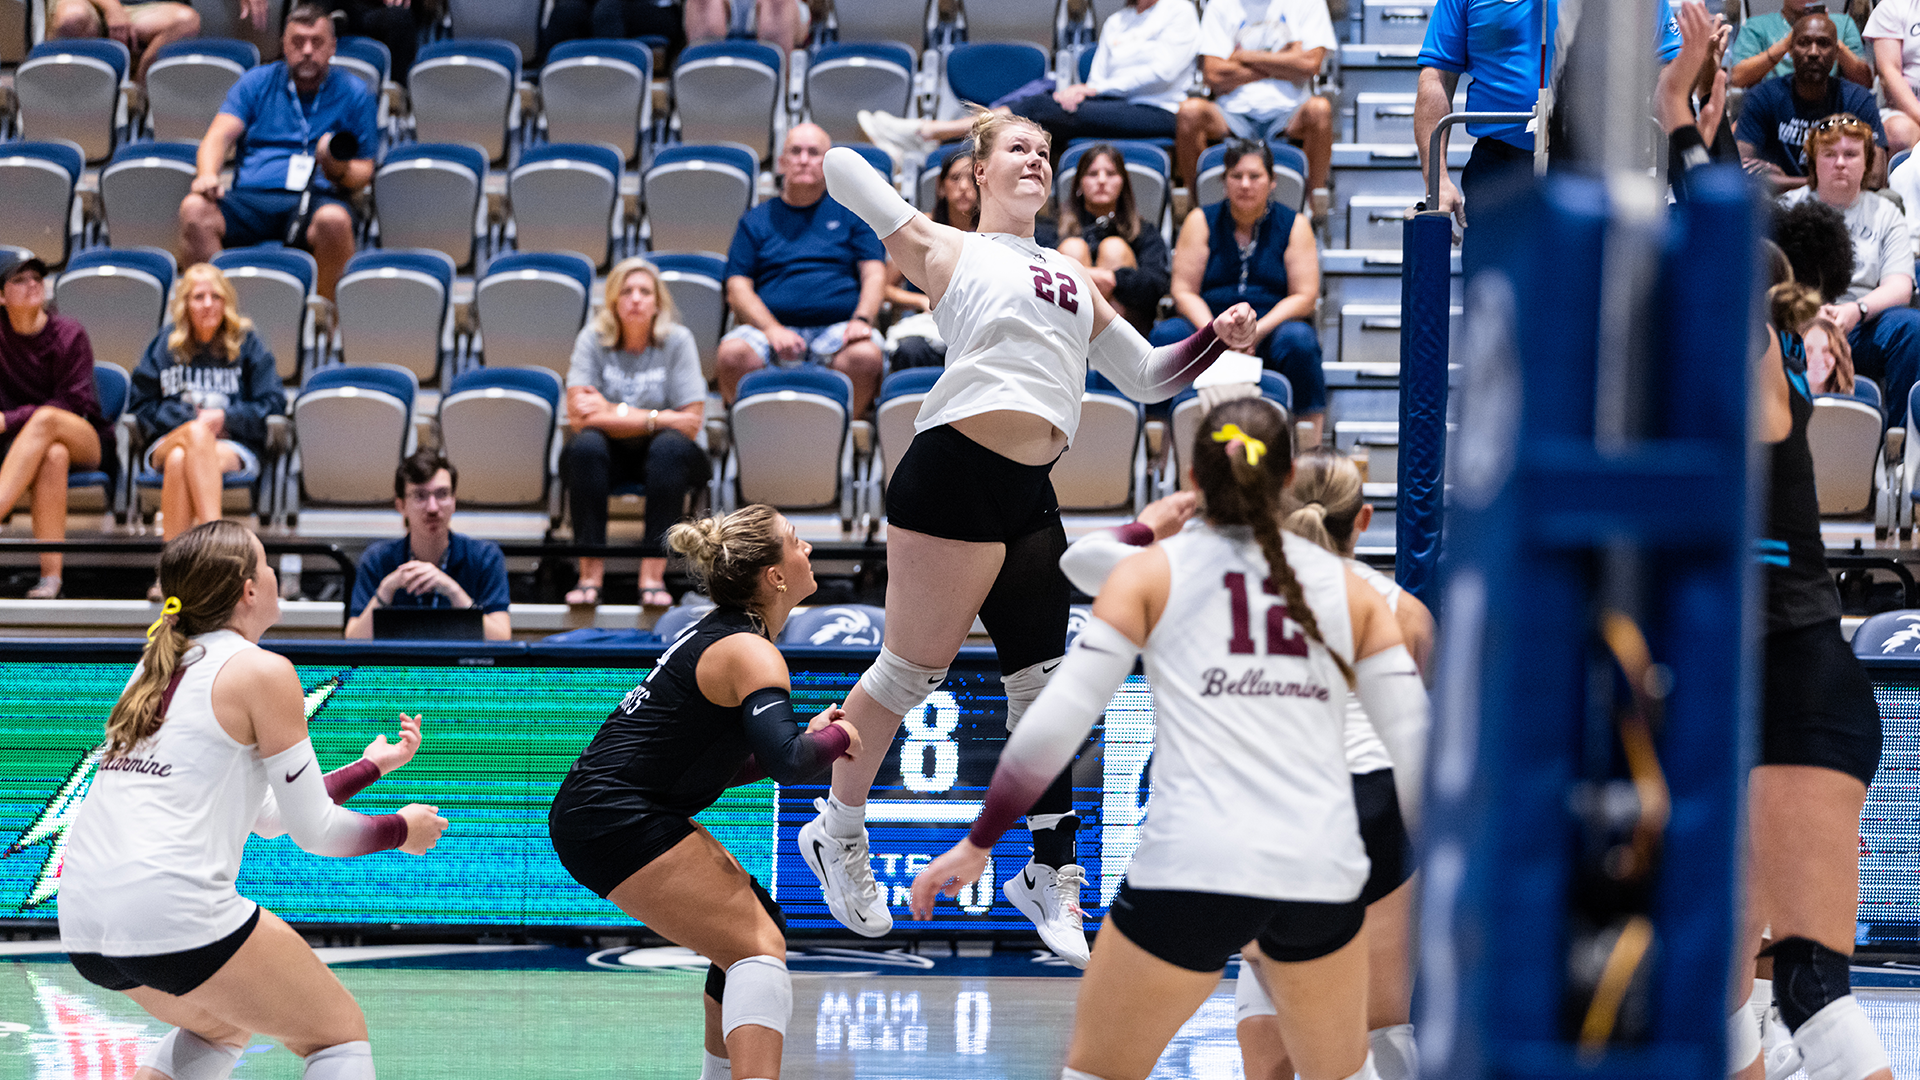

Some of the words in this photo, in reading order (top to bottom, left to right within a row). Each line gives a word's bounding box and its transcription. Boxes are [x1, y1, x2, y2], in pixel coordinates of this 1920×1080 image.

[1029, 265, 1079, 315] 22
[1224, 572, 1308, 659] 12
[900, 691, 960, 792] 8
